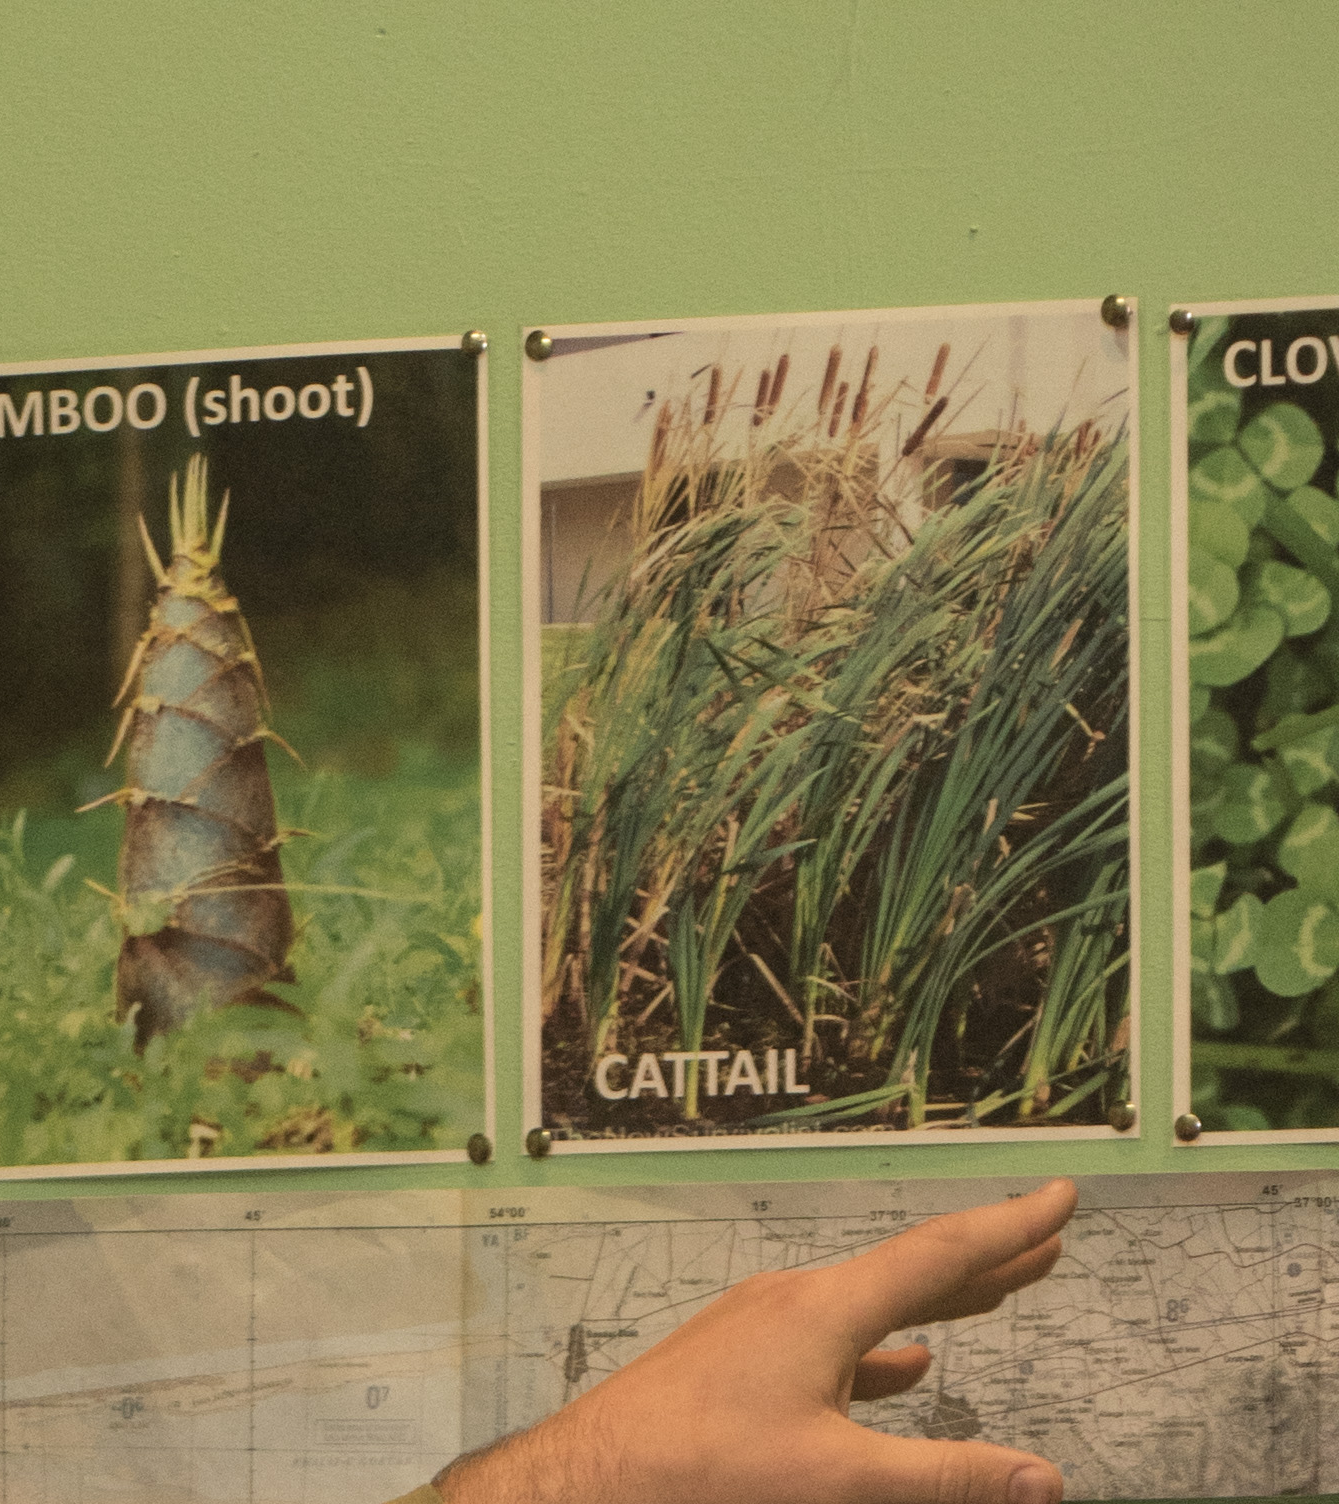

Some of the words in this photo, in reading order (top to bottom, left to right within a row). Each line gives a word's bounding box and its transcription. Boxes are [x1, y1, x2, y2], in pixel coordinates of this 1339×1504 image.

[1224, 335, 1339, 388] CLO
[184, 366, 374, 438] (shoot)
[595, 1048, 811, 1101] CATTAIL
